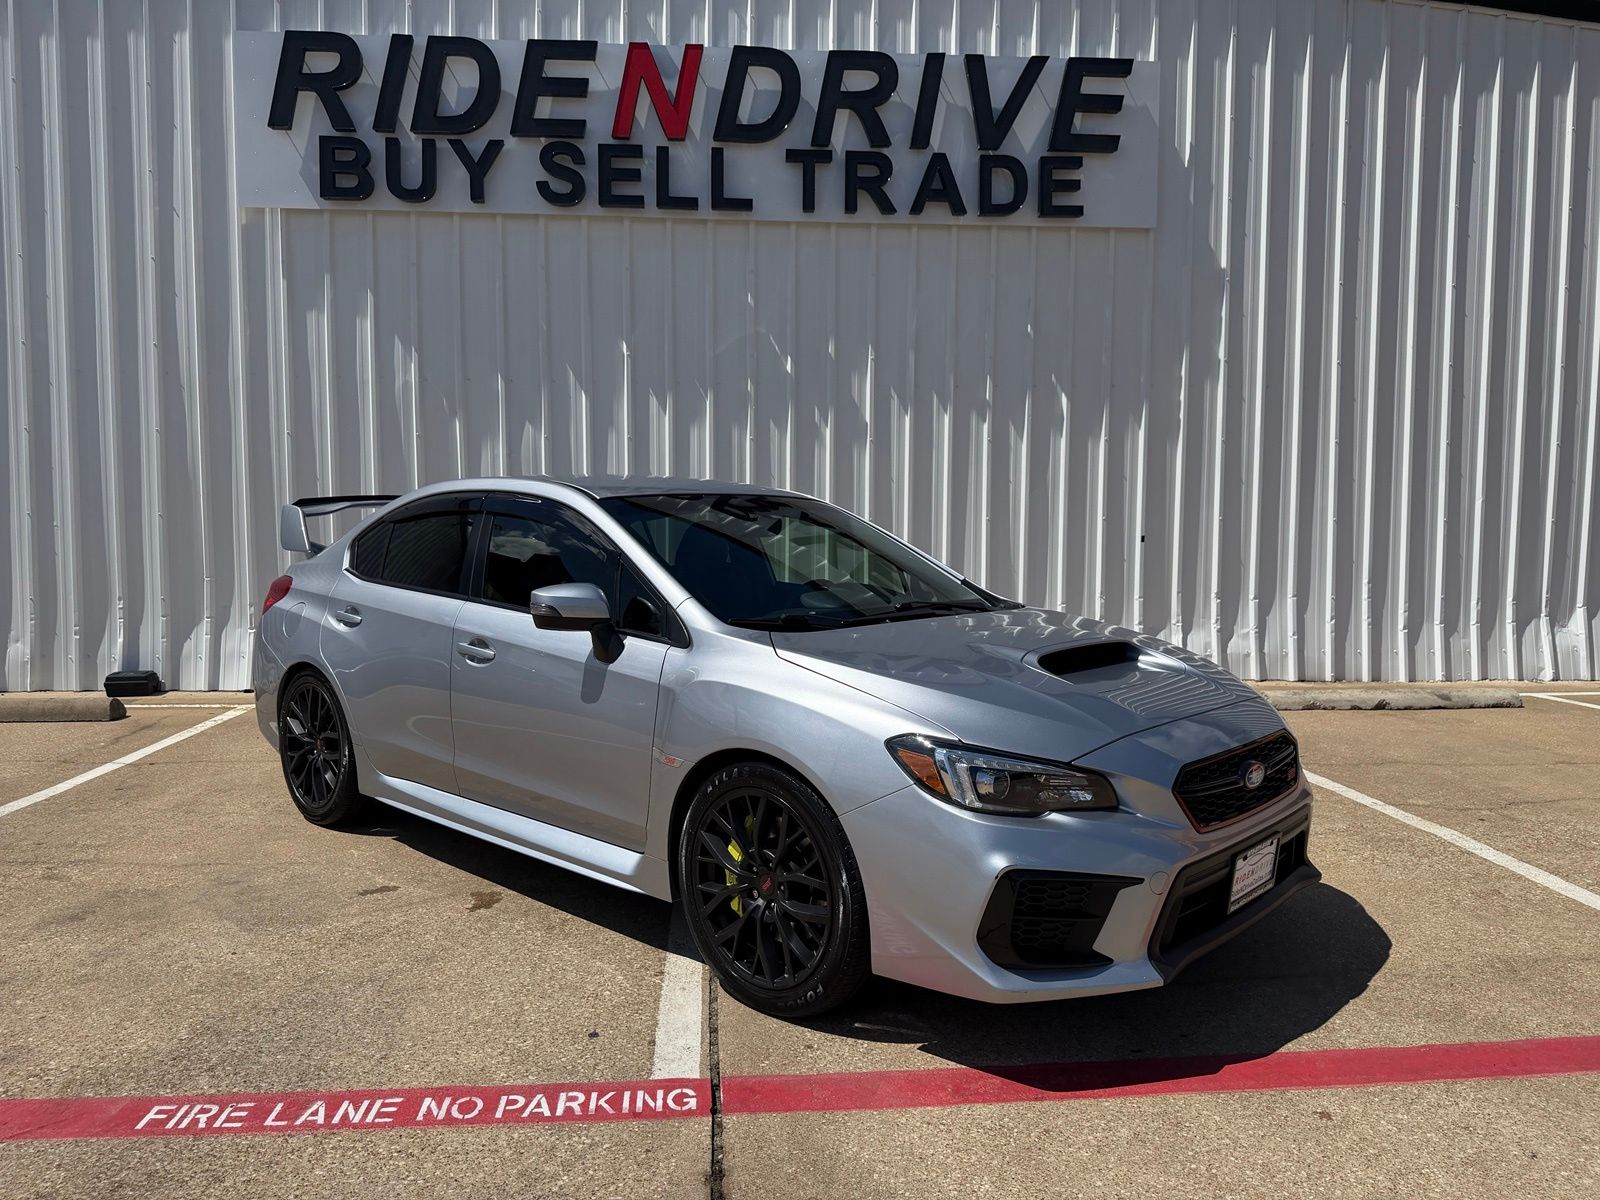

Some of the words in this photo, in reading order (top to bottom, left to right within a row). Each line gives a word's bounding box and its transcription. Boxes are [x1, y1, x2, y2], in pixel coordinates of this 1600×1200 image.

[267, 30, 1134, 153] RIDENDRIVE
[318, 134, 504, 204] BUY
[535, 140, 753, 211] SELL
[785, 148, 1085, 218] TRADE
[134, 1102, 257, 1131] FIRE
[263, 1096, 404, 1126] LANE
[415, 1095, 483, 1122] NO
[495, 1087, 699, 1118] PARKING
